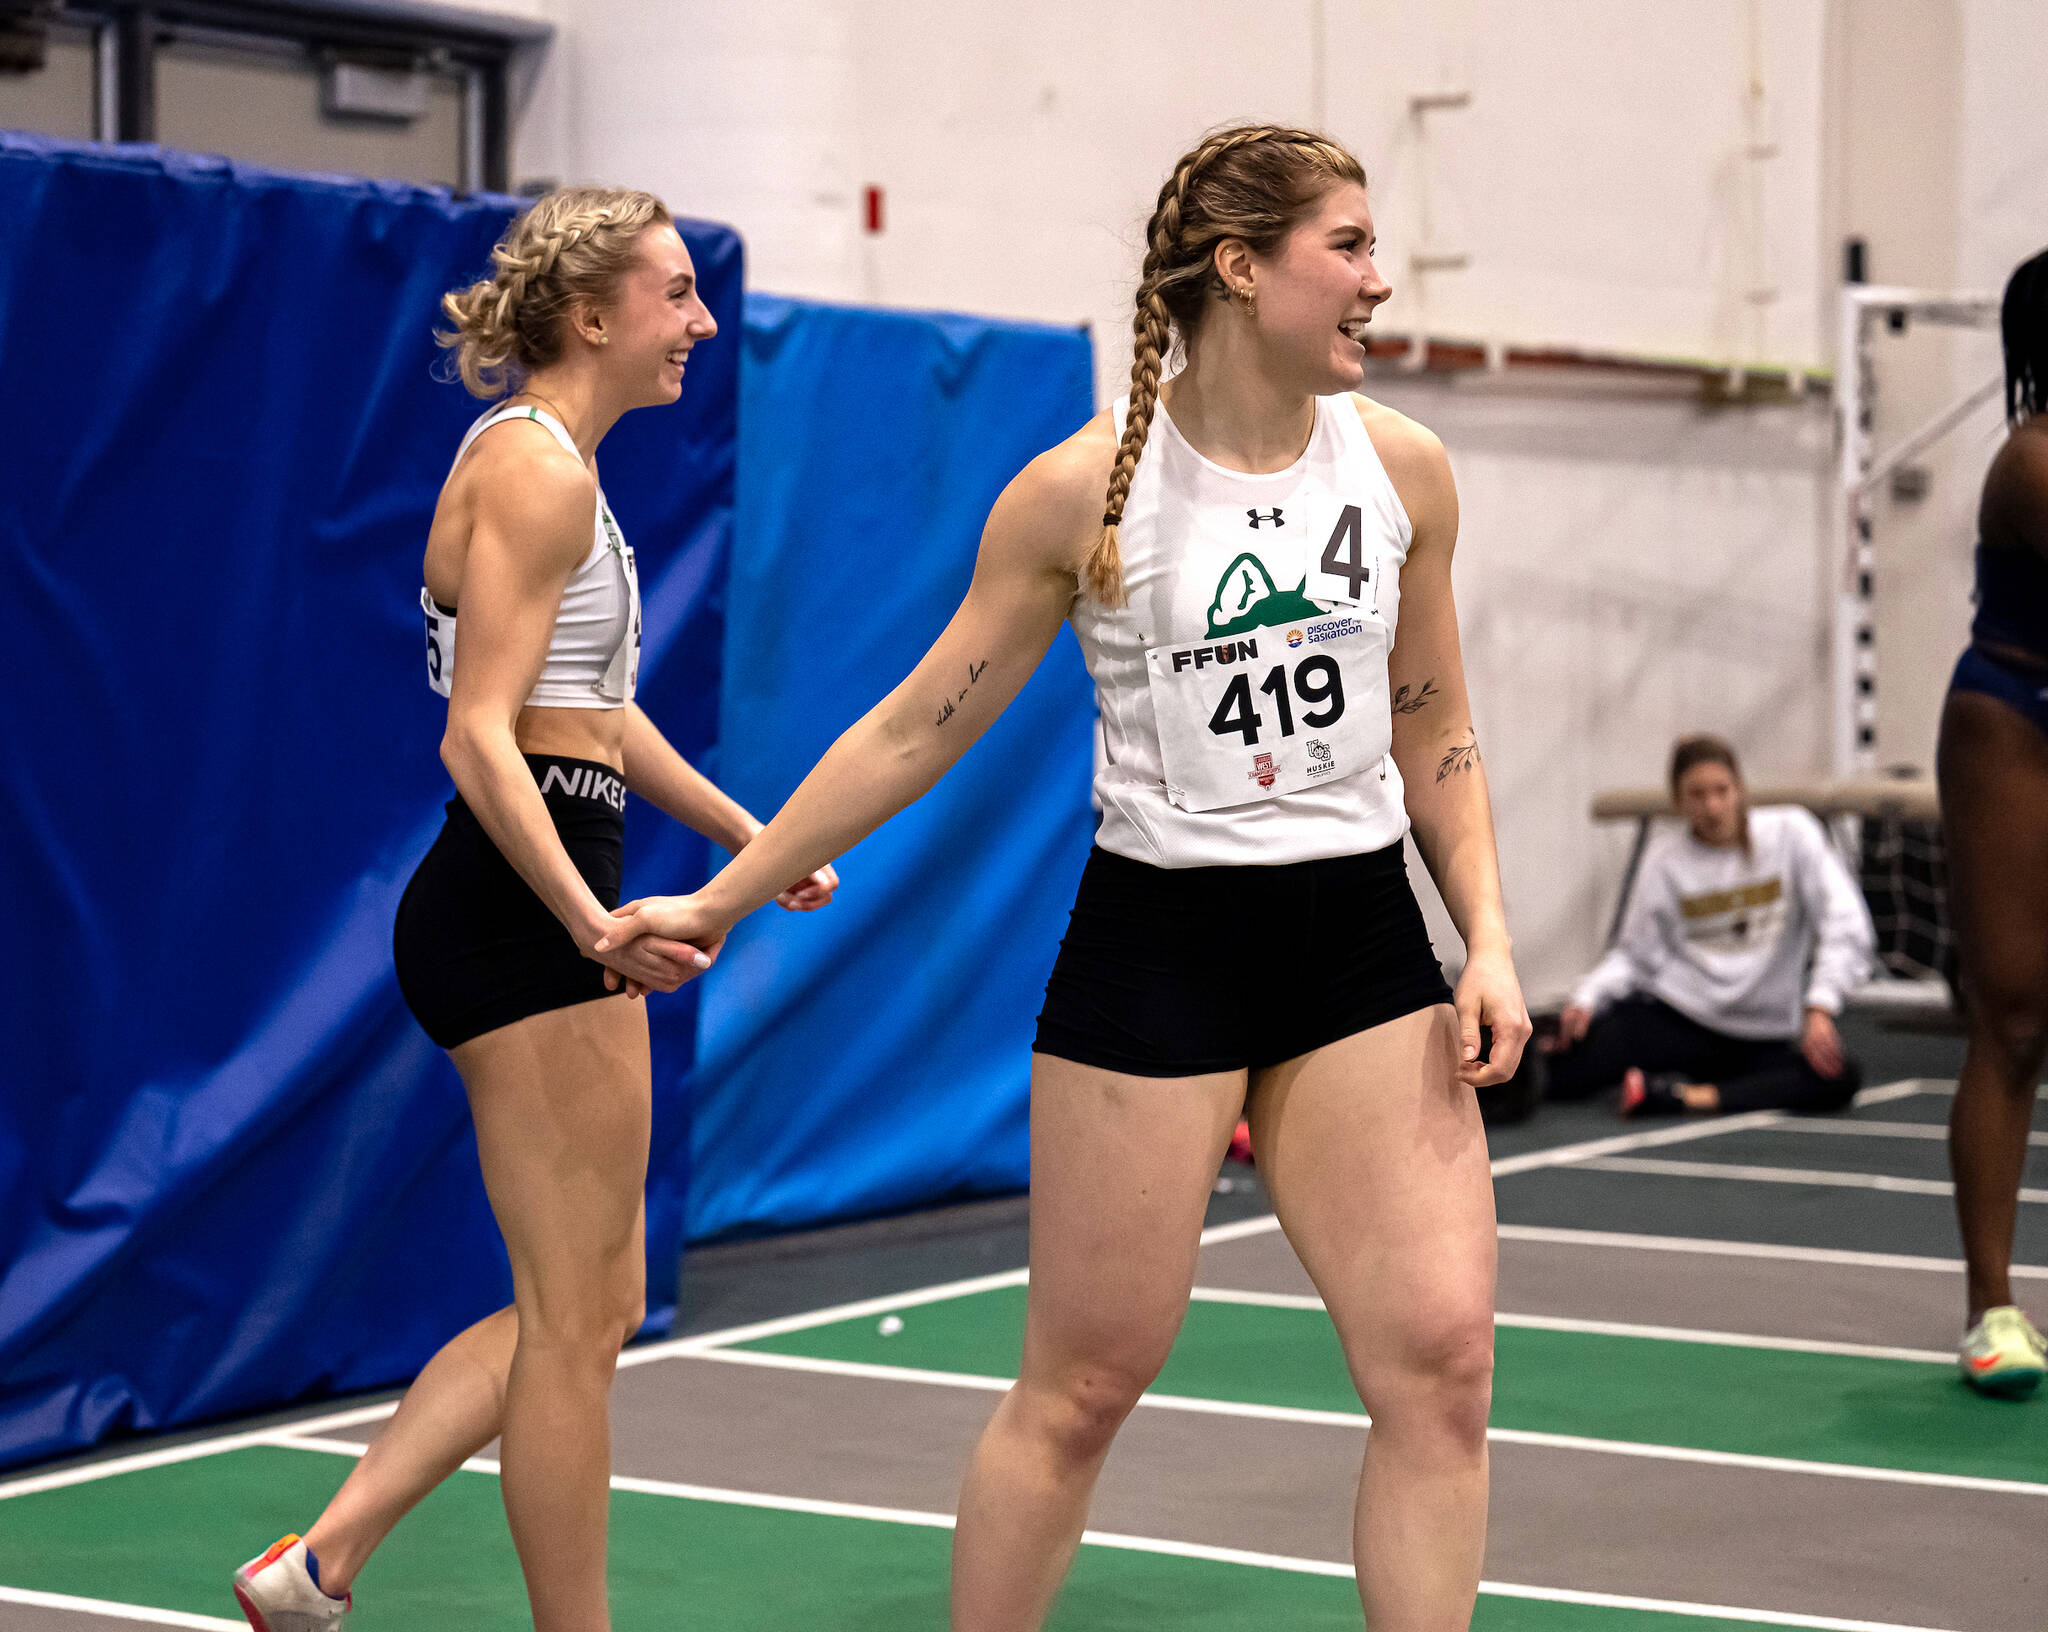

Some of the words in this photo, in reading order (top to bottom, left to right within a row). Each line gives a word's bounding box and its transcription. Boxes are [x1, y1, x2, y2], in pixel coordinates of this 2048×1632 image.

[1320, 504, 1370, 600] 4
[1172, 638, 1259, 673] FFUN
[1208, 655, 1345, 746] 419
[540, 765, 621, 810] NIKE
[1306, 760, 1335, 774] HUSKIE
